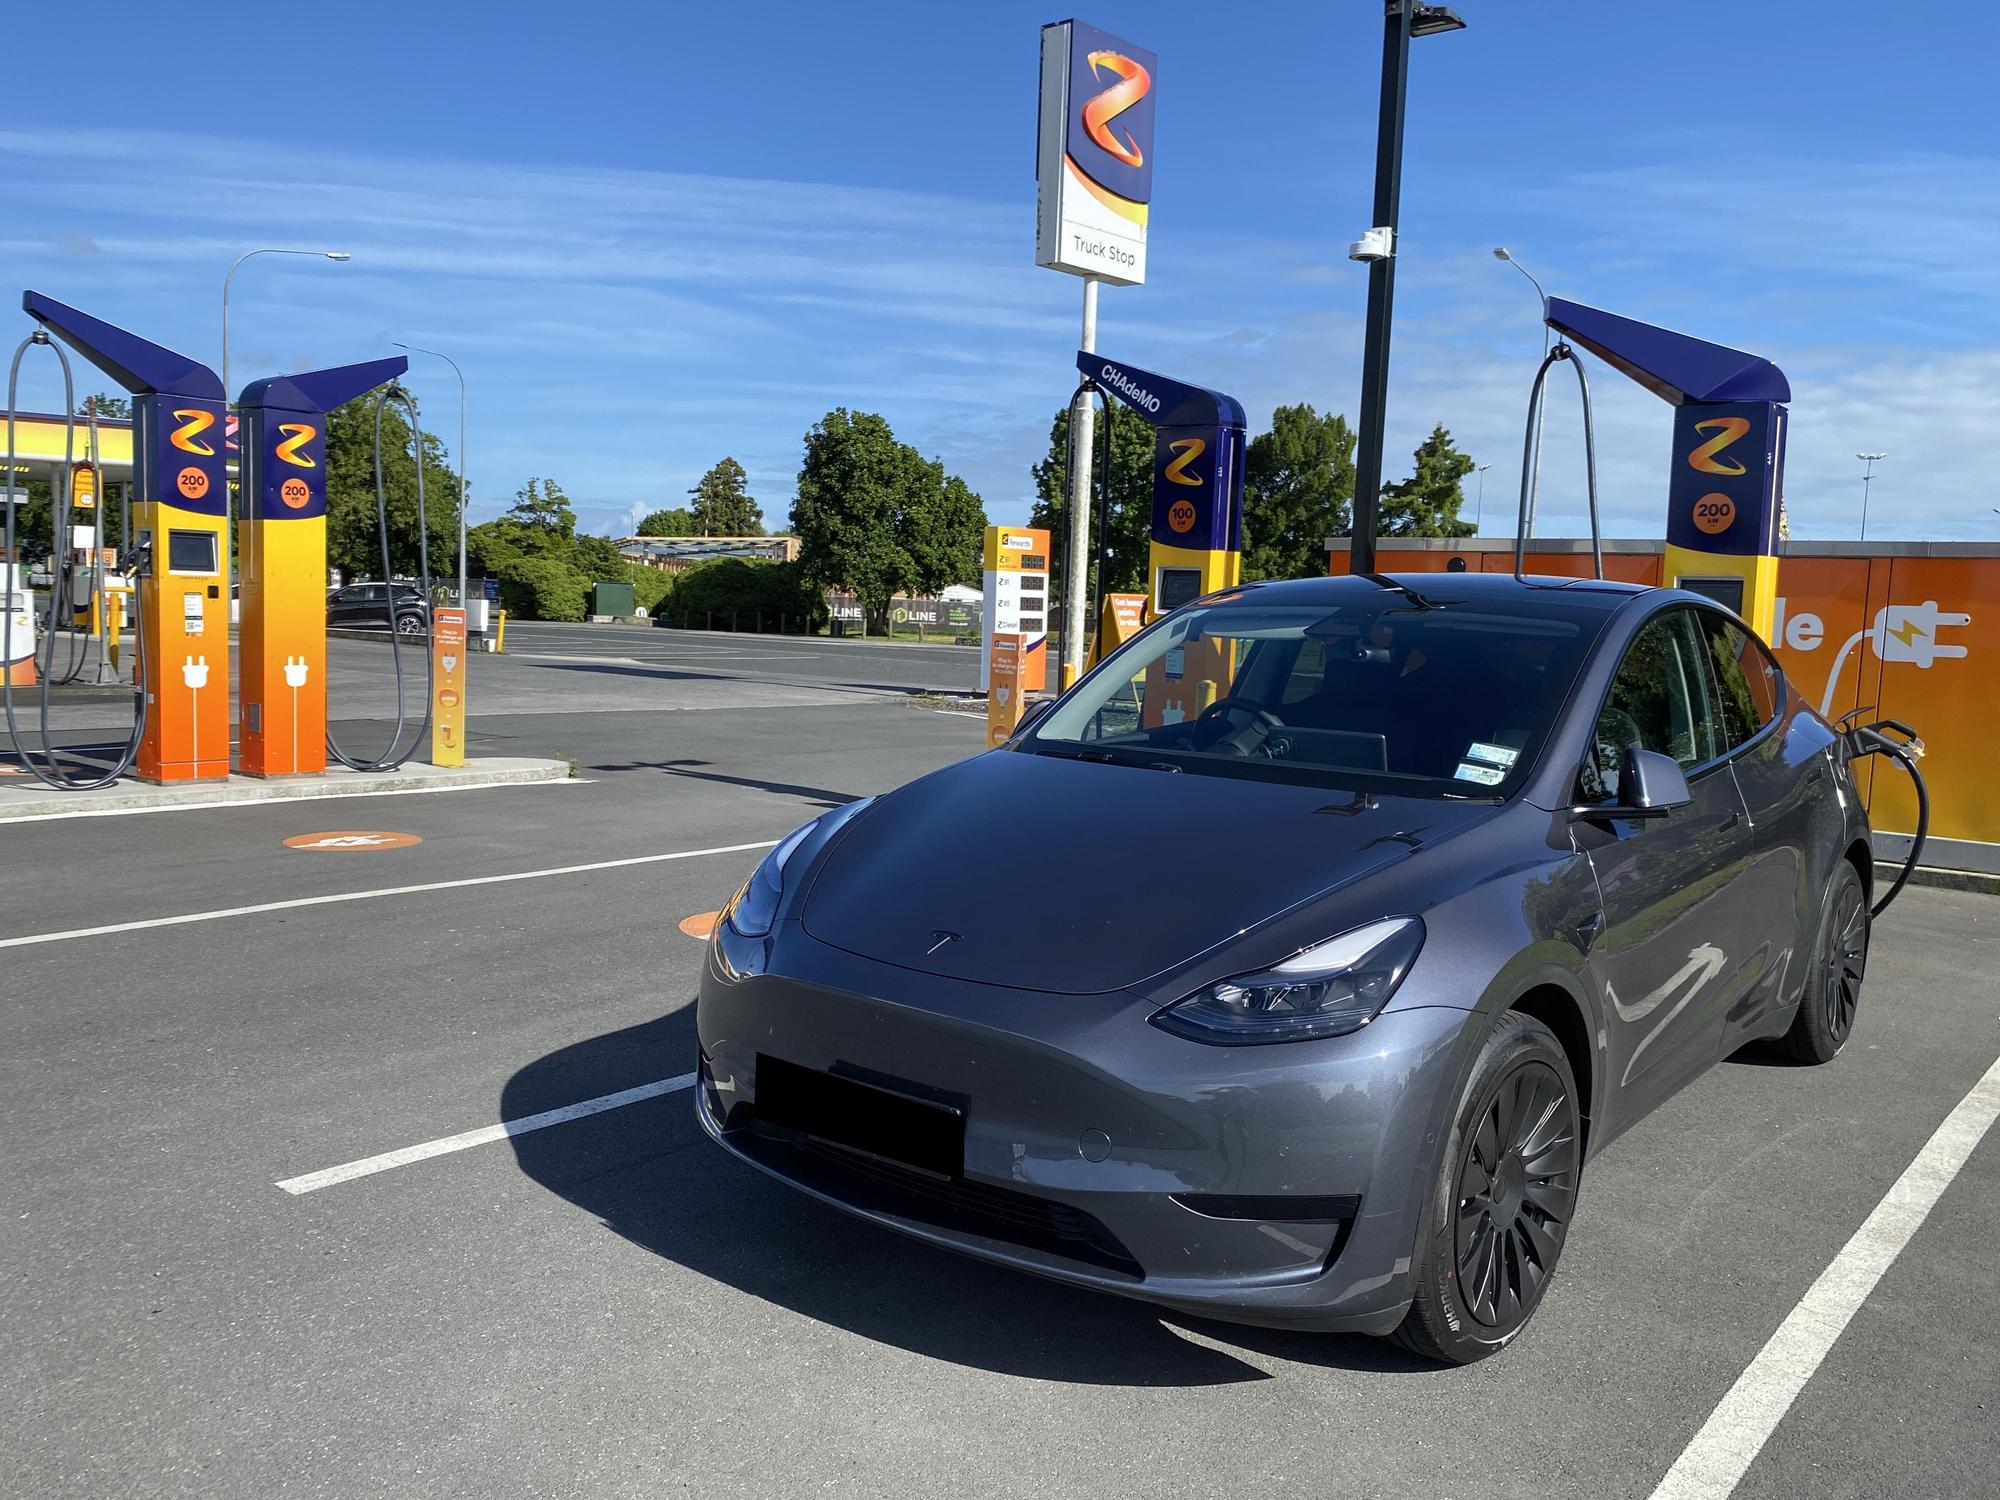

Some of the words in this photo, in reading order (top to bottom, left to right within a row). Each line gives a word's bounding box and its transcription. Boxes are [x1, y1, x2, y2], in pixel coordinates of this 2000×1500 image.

[1074, 235, 1106, 258] Truck
[1109, 246, 1135, 268] Stop
[1101, 364, 1161, 413] CHAdeMO
[181, 475, 205, 486] 200
[285, 486, 306, 496] 200
[1172, 508, 1193, 519] 100
[1698, 503, 1731, 517] 200
[1009, 539, 1031, 548] Rewards
[833, 607, 862, 618] LINE
[908, 611, 937, 622] LINE
[1003, 621, 1018, 629] Diesel
